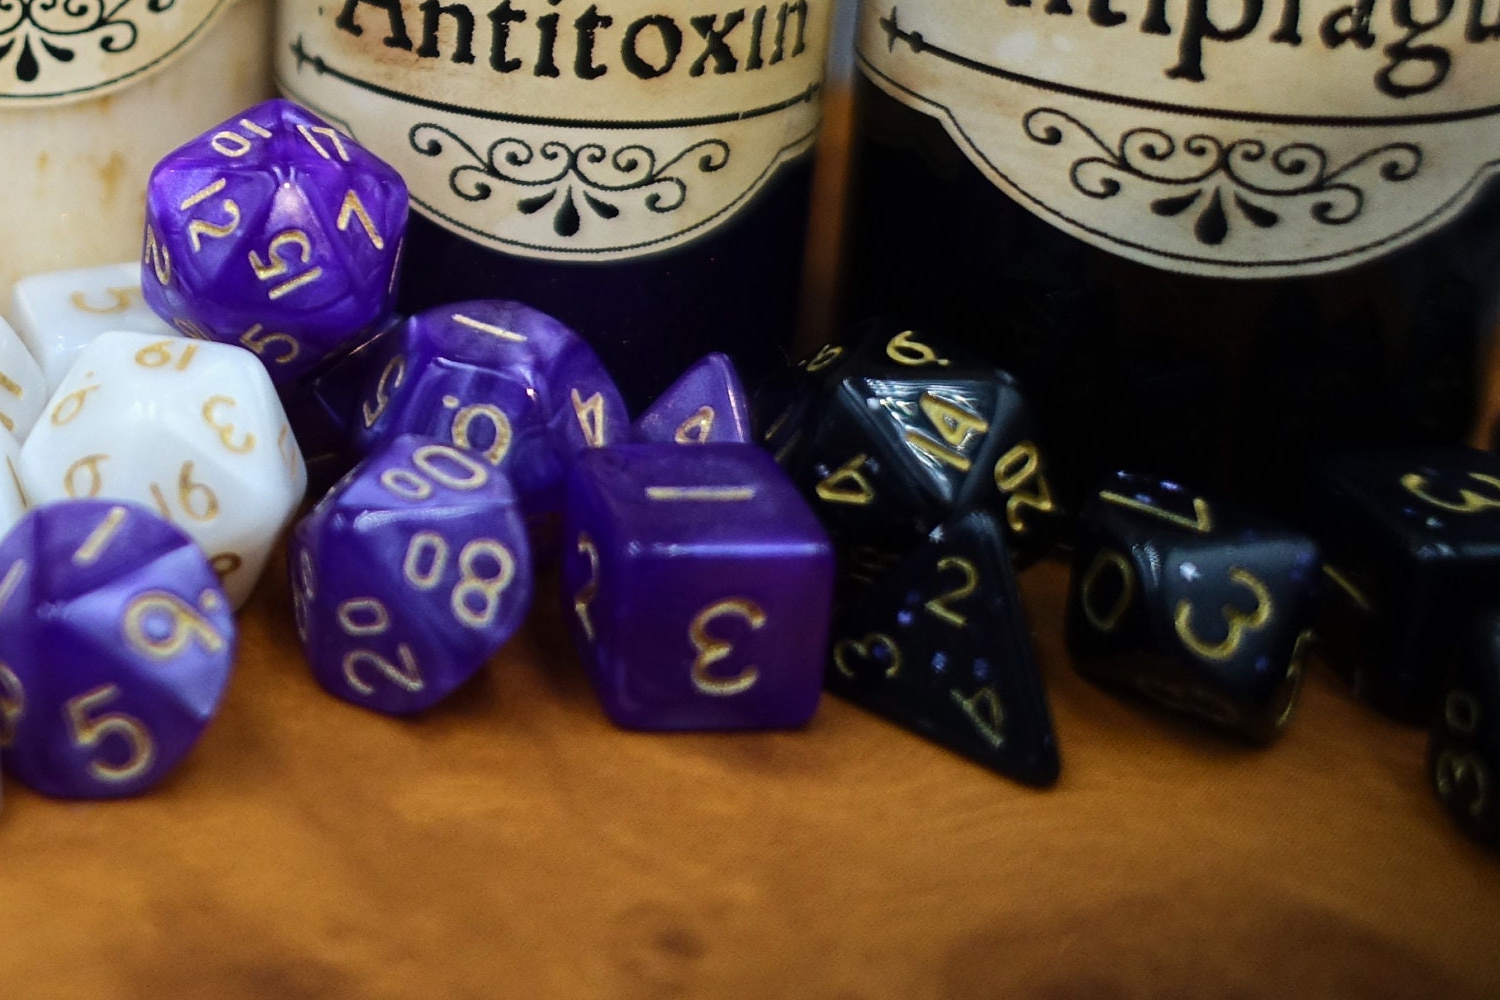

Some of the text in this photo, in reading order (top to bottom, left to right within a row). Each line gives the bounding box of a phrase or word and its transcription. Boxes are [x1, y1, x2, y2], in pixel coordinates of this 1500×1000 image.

[923, 556, 979, 628] 2
[1174, 565, 1273, 661] 3
[688, 598, 767, 696] 3
[63, 683, 156, 783] 5
